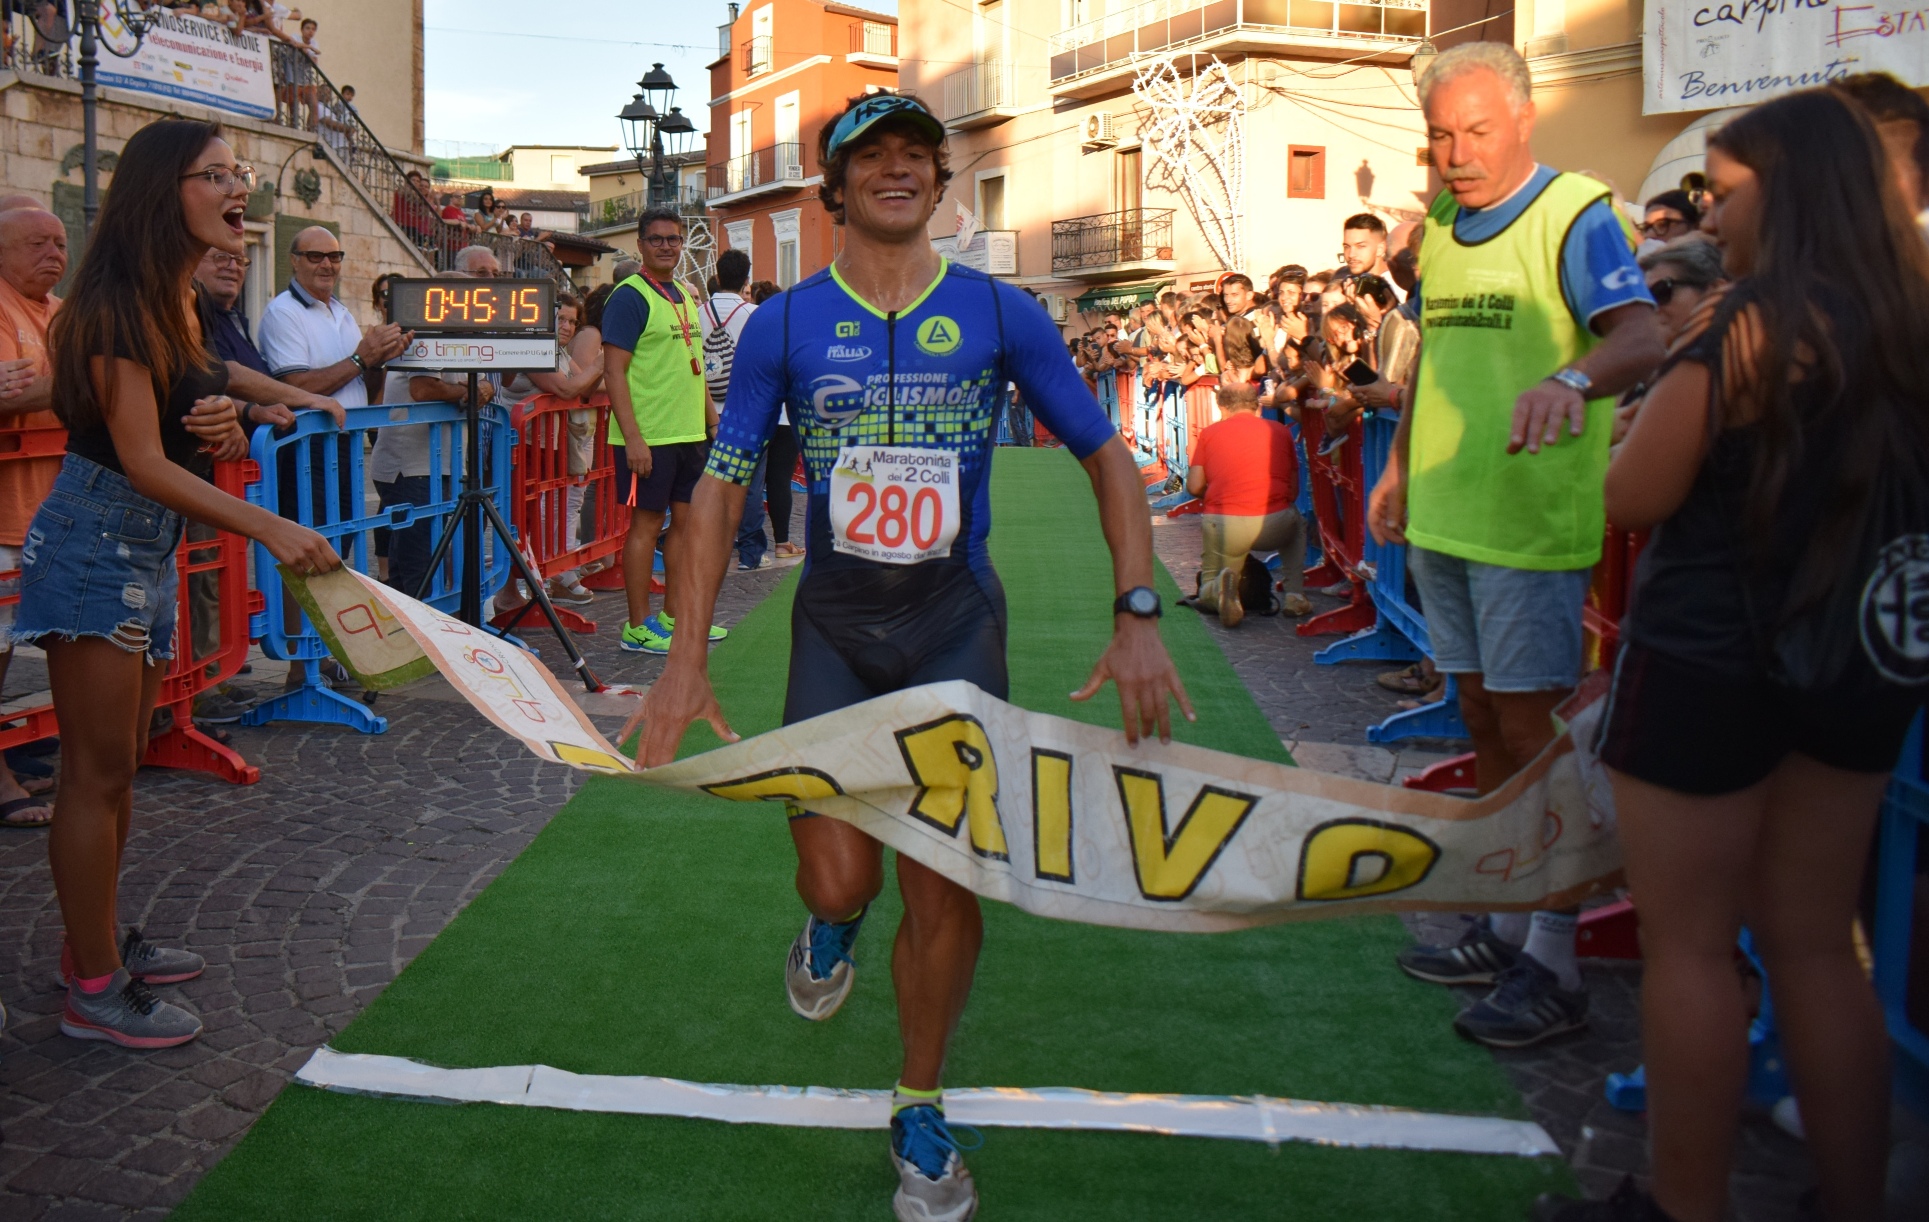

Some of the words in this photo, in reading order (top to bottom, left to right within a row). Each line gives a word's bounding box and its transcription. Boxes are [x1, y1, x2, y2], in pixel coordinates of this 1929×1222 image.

[160, 13, 221, 42] NOSERVICE
[148, 33, 228, 62] Telecomunicazione
[236, 52, 264, 73] Energia
[425, 287, 539, 323] 0:45:15
[435, 341, 494, 362] timing
[873, 451, 951, 468] Maratonina
[888, 472, 902, 482] dei
[905, 467, 918, 482] 2
[920, 469, 950, 485] Colli
[846, 482, 943, 550] 280
[872, 549, 879, 557] in
[881, 550, 912, 560] agosto
